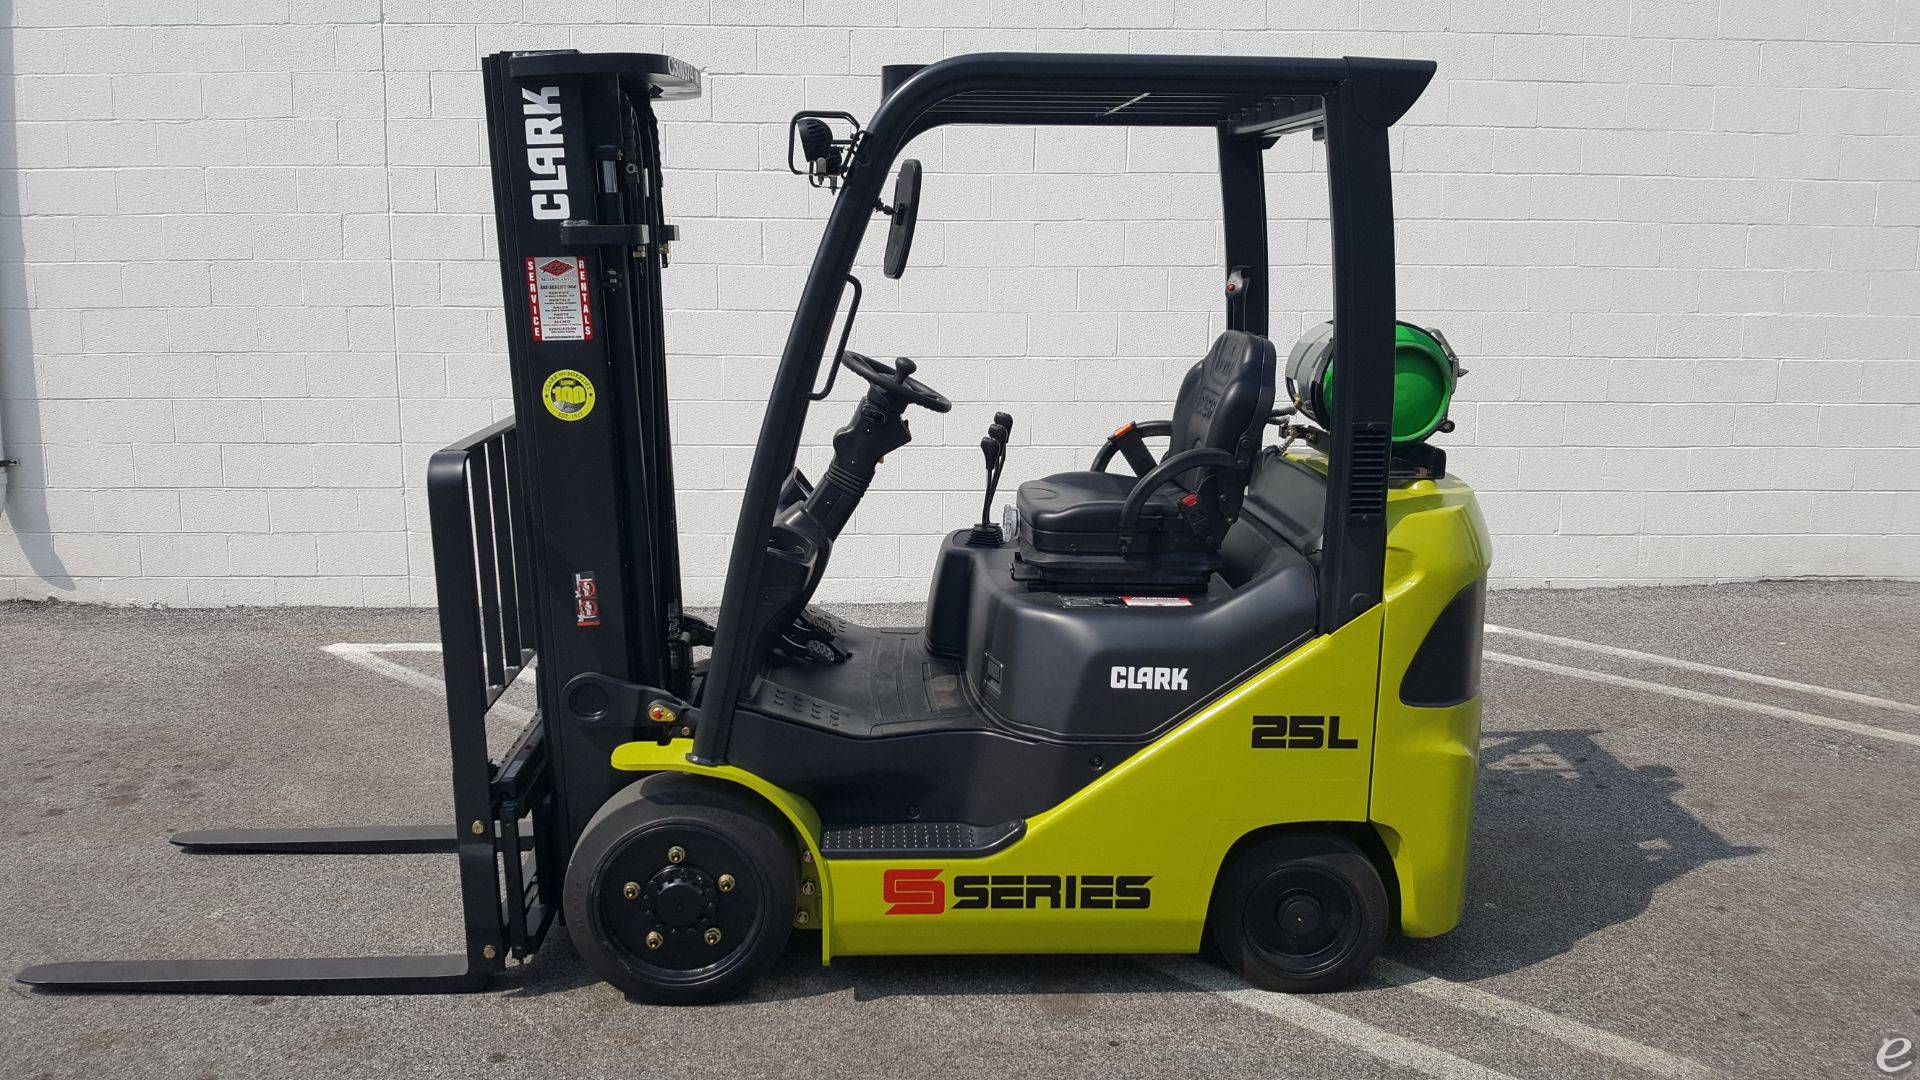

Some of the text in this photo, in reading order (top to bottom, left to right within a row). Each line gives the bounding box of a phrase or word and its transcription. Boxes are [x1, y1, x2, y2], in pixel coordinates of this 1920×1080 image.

[521, 86, 571, 220] CLARK
[527, 261, 541, 337] SERVICE
[578, 260, 591, 336] RENTALS
[552, 385, 586, 404] 100
[1110, 666, 1189, 691] CLARK
[1251, 715, 1359, 749] 25L
[950, 875, 1155, 910] SERIES
